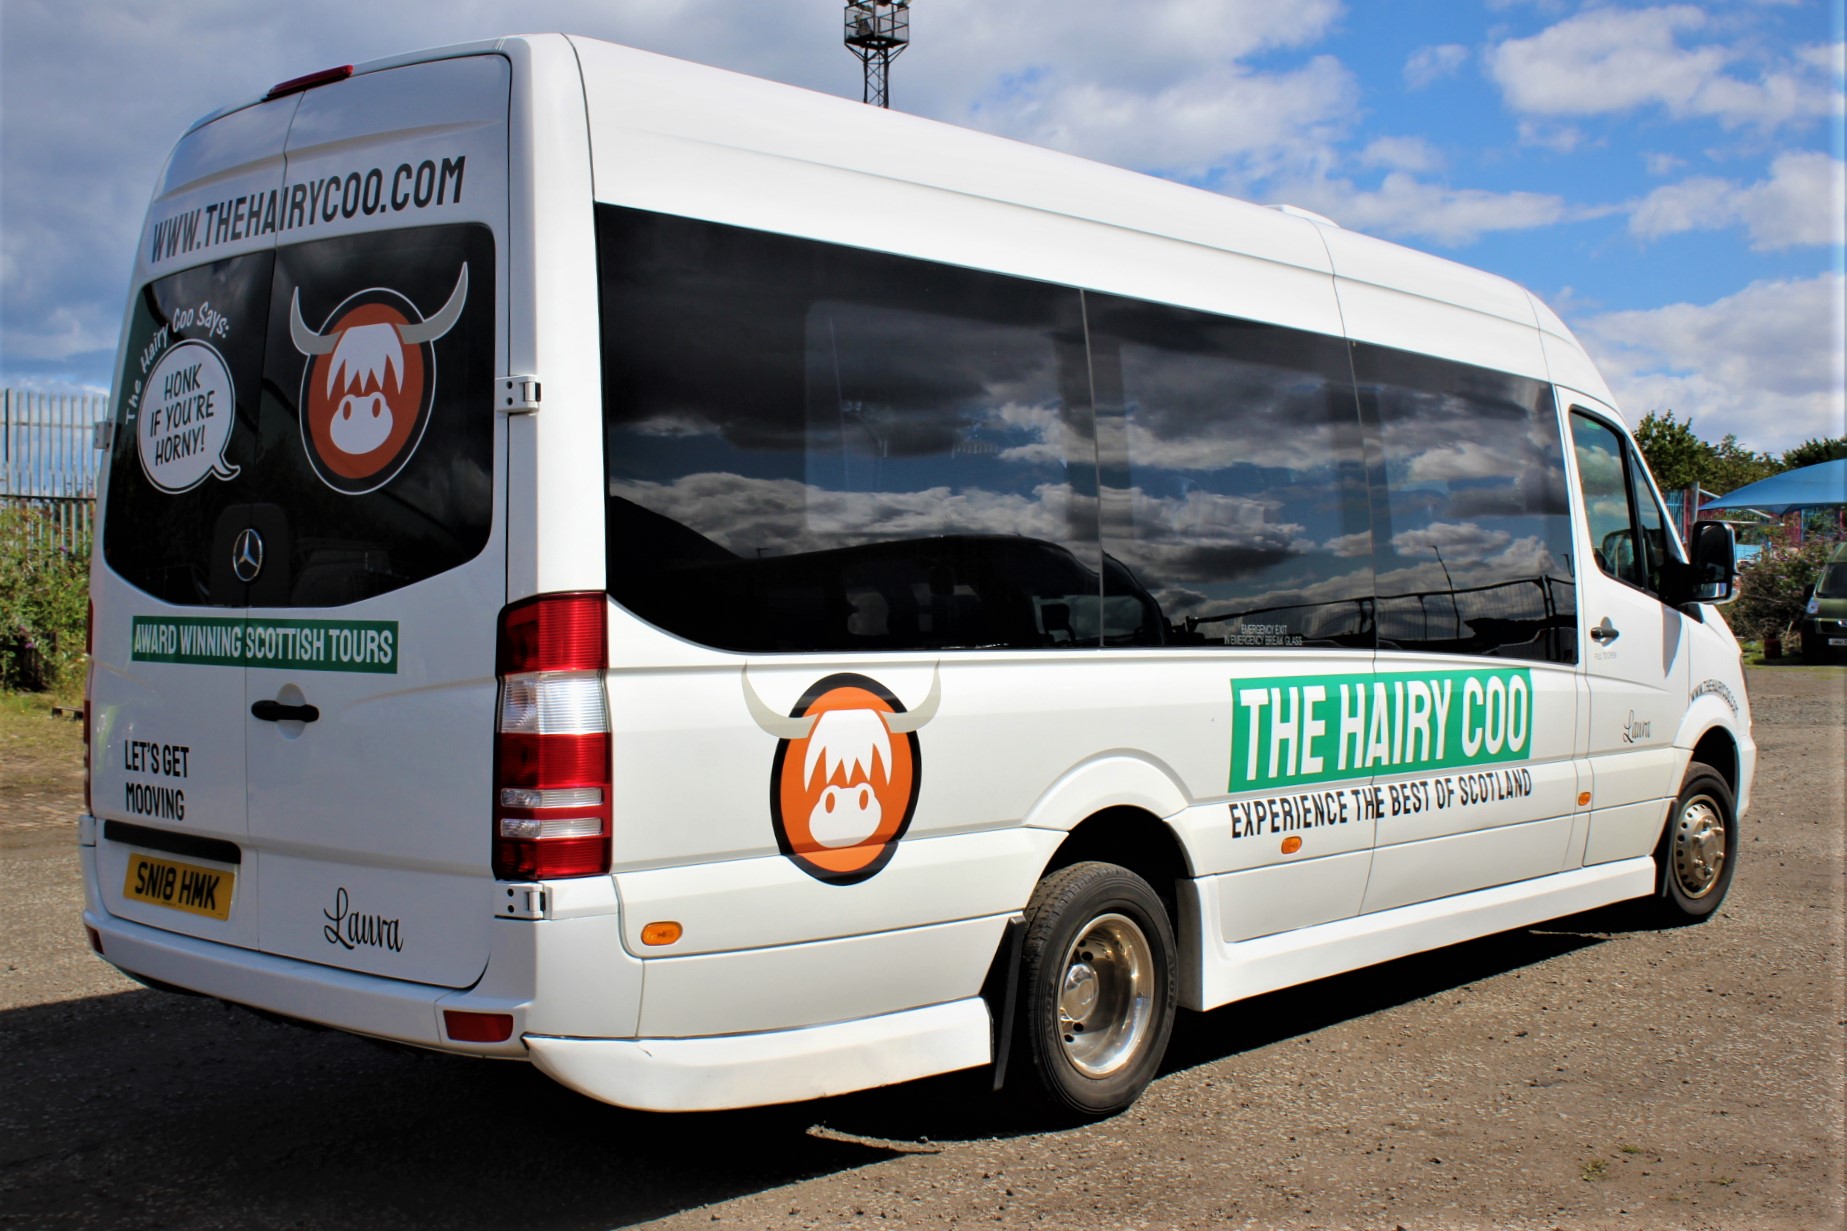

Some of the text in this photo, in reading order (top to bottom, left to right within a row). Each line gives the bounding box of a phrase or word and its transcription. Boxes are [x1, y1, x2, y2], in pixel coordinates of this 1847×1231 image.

[151, 155, 466, 264] WWW.THEHAIRYCOO.COM
[125, 301, 230, 425] The Hairy Coo Says:
[164, 363, 202, 401] HONK
[150, 390, 215, 438] IF YOU'RE
[155, 425, 206, 467] HORNY!
[134, 624, 393, 664] AWARD WINNING SCOTTISH TOURS
[1275, 624, 1287, 635] EXIT
[1284, 636, 1303, 646] GLASS
[1239, 674, 1528, 781] THE HAIRY COO
[1622, 709, 1651, 743] Laura
[124, 739, 190, 778] LET'S GET
[125, 782, 185, 822] MOOVING
[1228, 768, 1533, 839] EXPERIENCE THE BEST OF SCOTLAND
[134, 861, 220, 911] SN18 HMK
[323, 887, 404, 953] Laura
